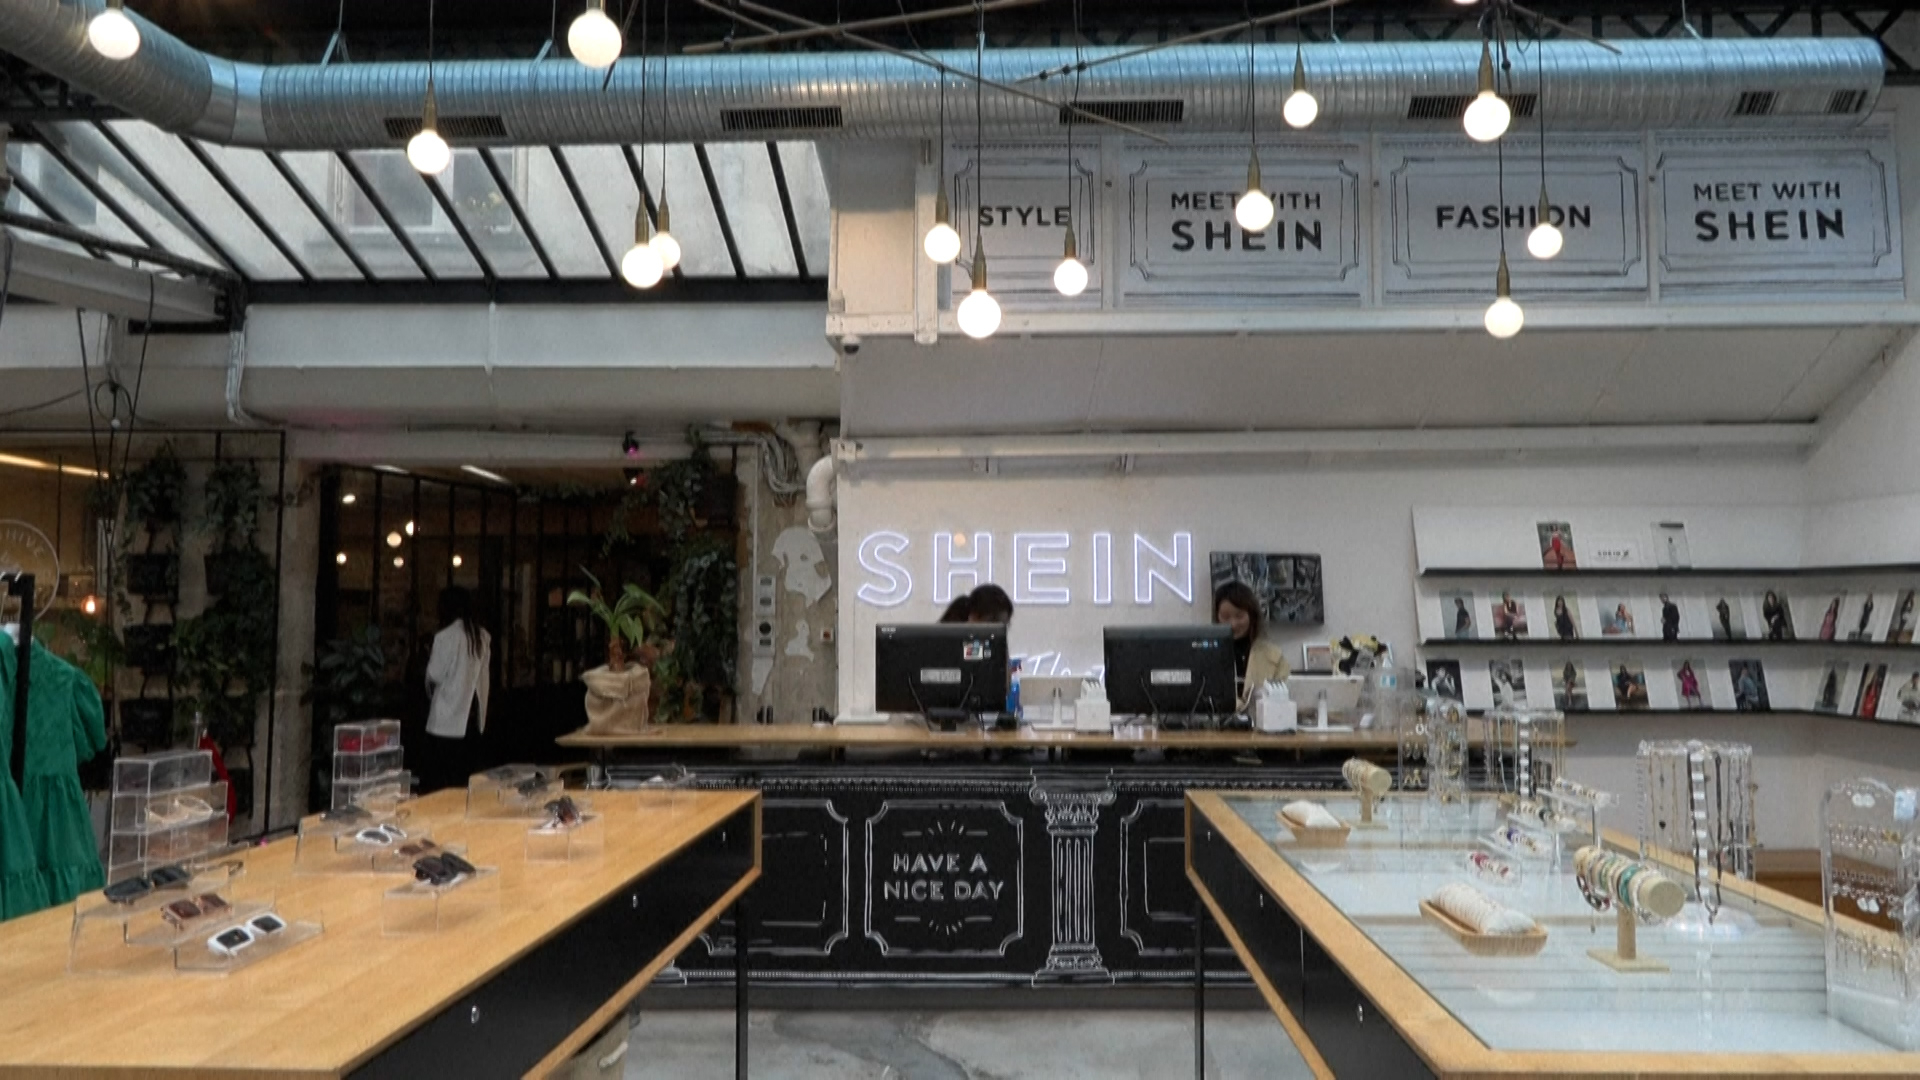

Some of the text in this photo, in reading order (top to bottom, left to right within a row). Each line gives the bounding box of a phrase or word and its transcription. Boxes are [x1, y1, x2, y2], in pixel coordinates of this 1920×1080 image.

[1171, 192, 1321, 210] MEET ITH
[1693, 181, 1841, 201] MEET WITH
[979, 205, 1071, 227] STYLE
[1436, 204, 1591, 229] FASHION
[1694, 208, 1845, 242] SHEIN
[1171, 220, 1321, 251] SHEIN
[856, 530, 1194, 607] SHEIN
[893, 853, 988, 872] HAVE A
[883, 879, 1004, 901] NICE DAY
